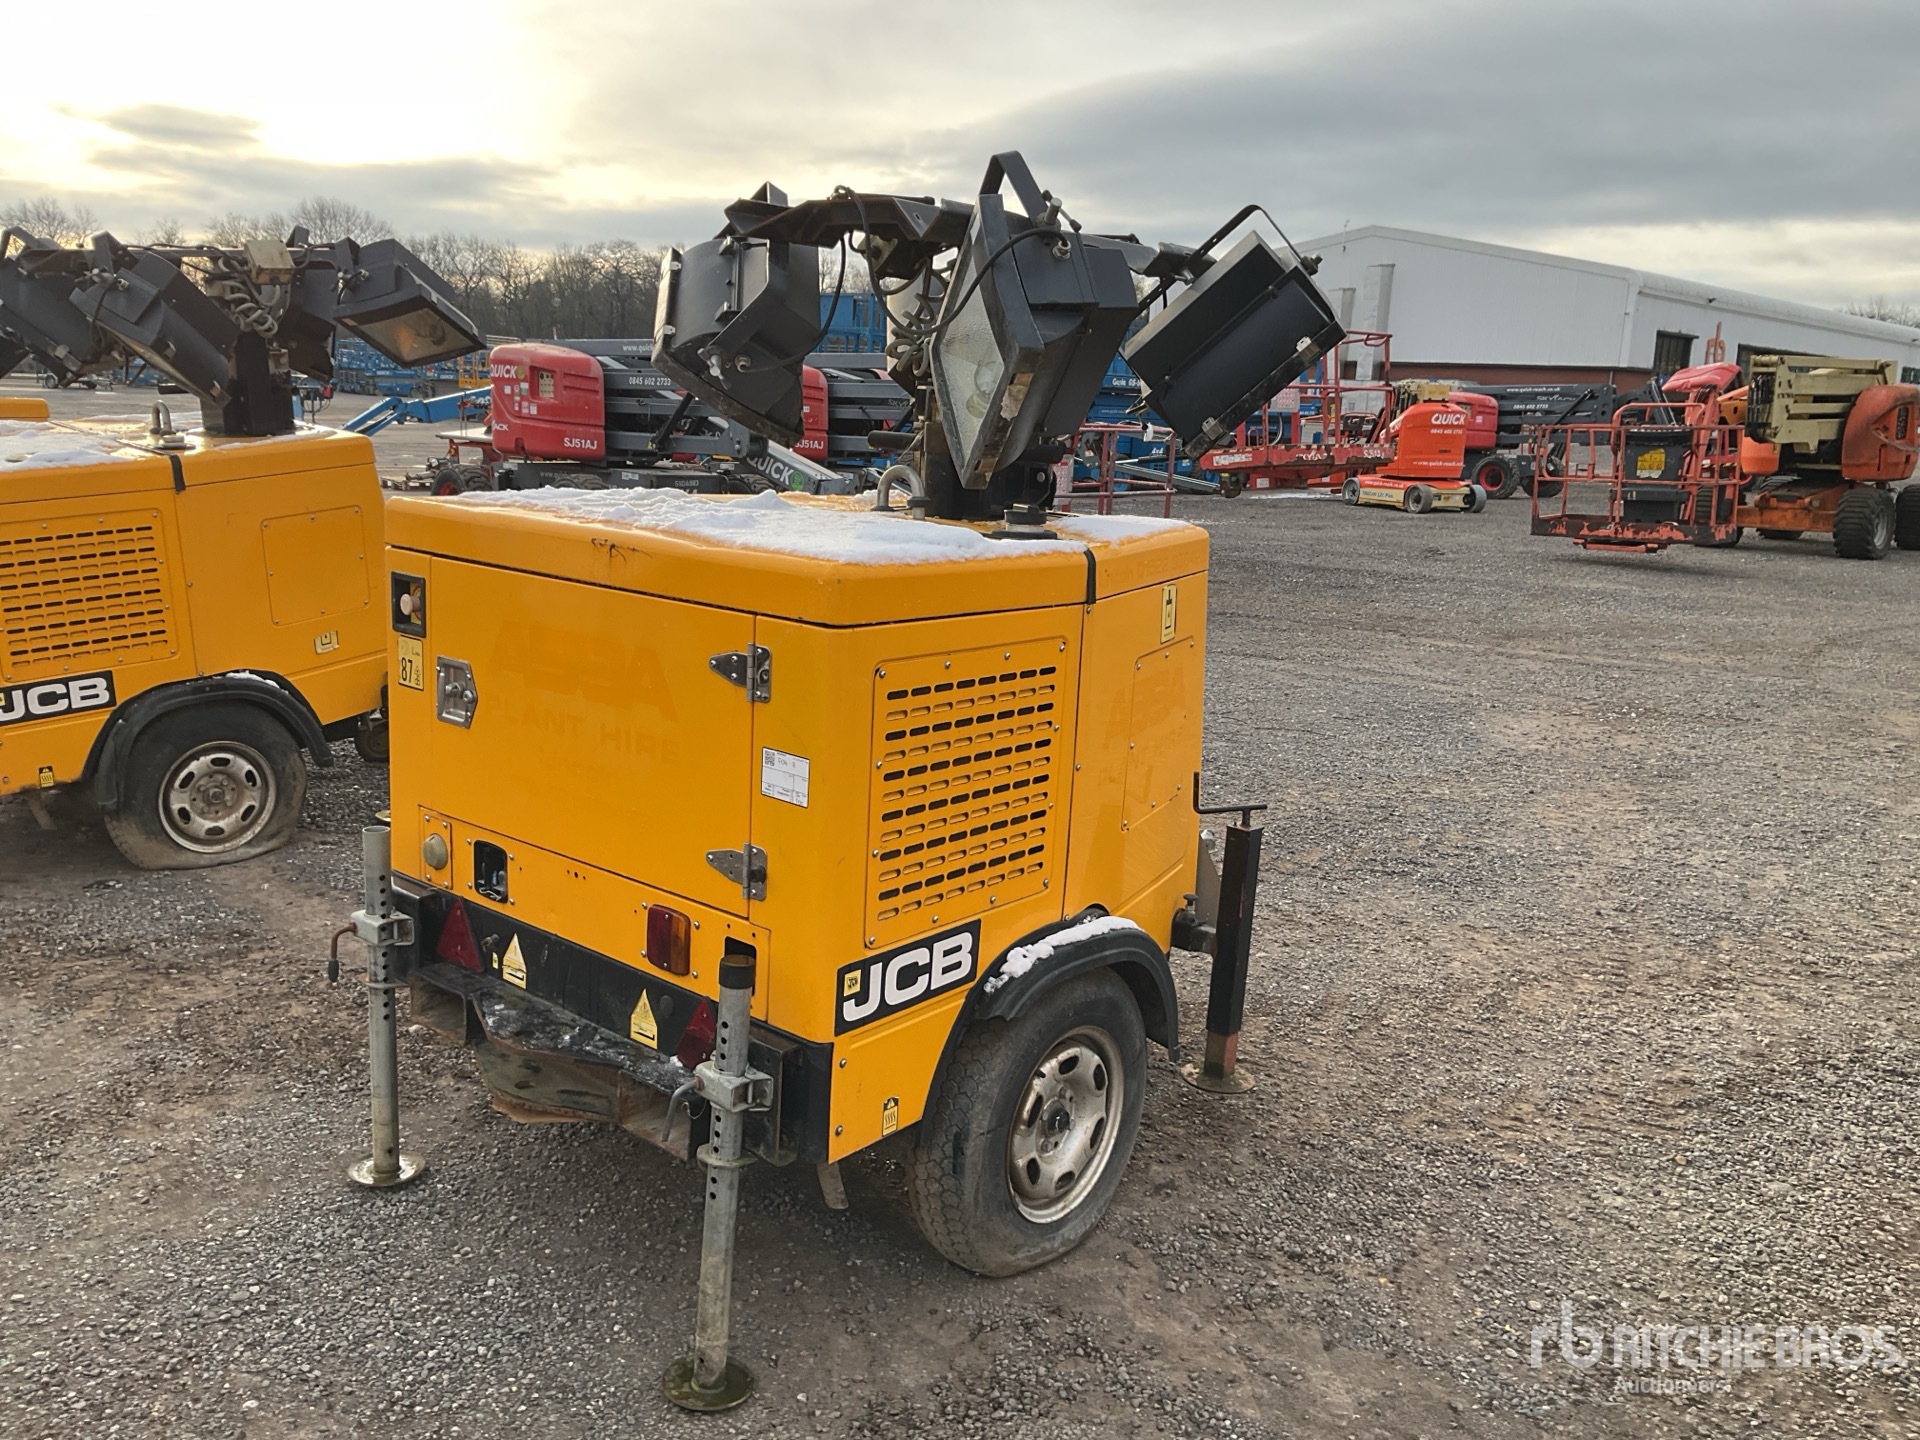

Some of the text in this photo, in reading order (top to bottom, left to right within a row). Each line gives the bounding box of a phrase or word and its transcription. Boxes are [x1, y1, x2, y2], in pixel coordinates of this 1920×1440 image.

[490, 364, 517, 379] QUICK
[628, 376, 672, 386] 0845 602 2733
[1431, 412, 1466, 426] QUICK
[564, 437, 598, 450] SJ51AJ
[401, 656, 413, 683] 87
[0, 677, 110, 721] JCB
[843, 932, 973, 1021] JCB
